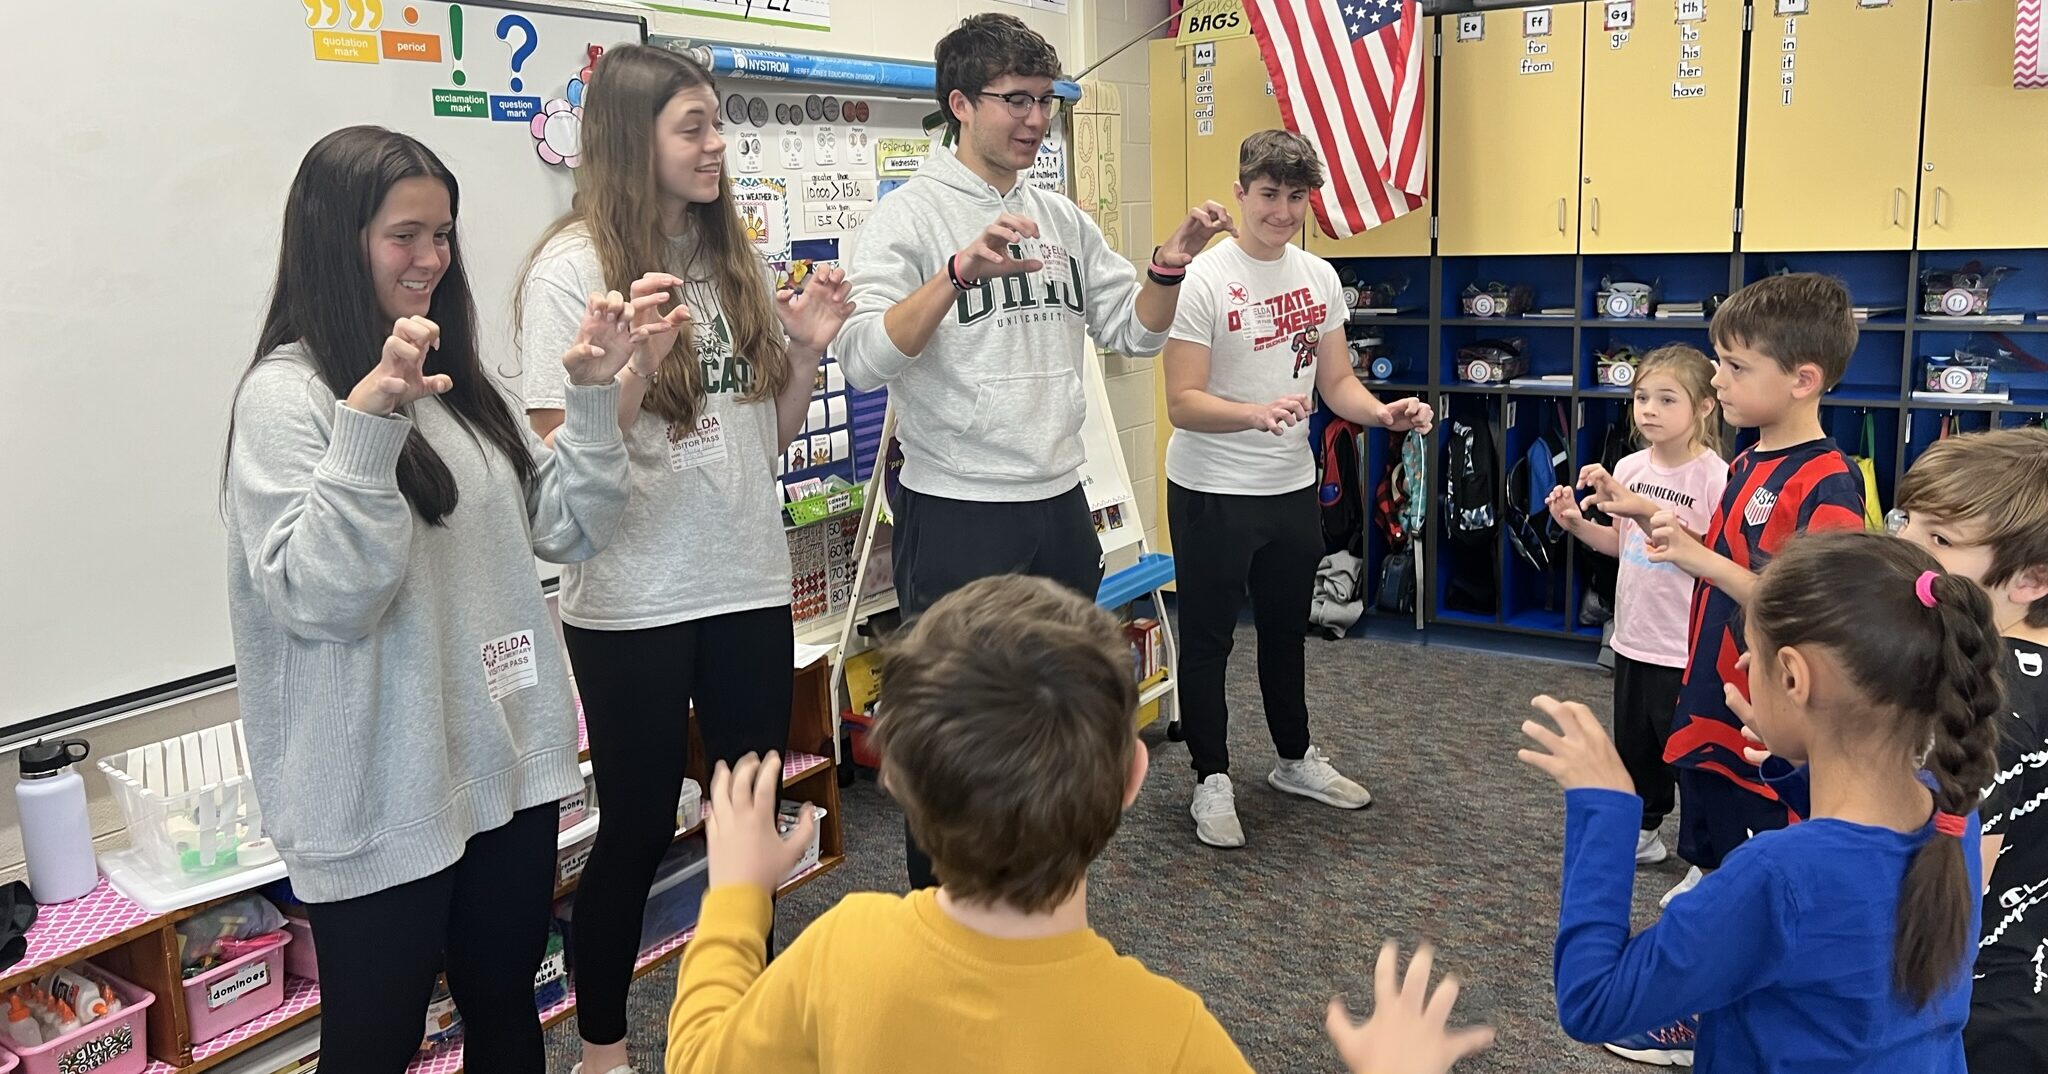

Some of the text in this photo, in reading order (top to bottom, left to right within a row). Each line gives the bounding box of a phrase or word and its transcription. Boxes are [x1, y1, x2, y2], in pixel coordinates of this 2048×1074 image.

[1188, 11, 1240, 34] BAGS
[1531, 16, 1544, 27] Ff
[1611, 10, 1628, 22] Gg
[1463, 22, 1478, 32] Ee
[1785, 18, 1796, 34] if
[1682, 26, 1698, 40] he
[322, 36, 369, 48] quotation
[397, 42, 426, 52] period
[1528, 41, 1546, 53] for
[1612, 33, 1628, 48] go
[1782, 39, 1795, 51] in
[334, 47, 360, 57] mark
[1197, 50, 1211, 59] Aa
[1682, 45, 1700, 59] his
[749, 59, 789, 74] NYSTROM
[1521, 60, 1552, 73] from
[1782, 54, 1793, 68] it
[827, 70, 855, 80] EDUCATION
[855, 73, 876, 81] DIVISION
[1199, 70, 1211, 82] all
[1679, 63, 1701, 77] her
[1782, 73, 1793, 85] is
[1197, 84, 1213, 92] are
[1673, 83, 1704, 98] have
[435, 94, 485, 104] exclamation
[499, 100, 533, 111] question
[1197, 95, 1213, 103] am
[450, 103, 472, 113] mark
[506, 109, 527, 118] mark
[1195, 105, 1214, 118] and
[1199, 120, 1212, 133] an
[878, 140, 930, 154] Yesterday was
[891, 159, 919, 167] Wednesday
[746, 192, 772, 201] WEATHER
[1480, 302, 1487, 312] 5
[1615, 300, 1623, 310] 7
[1475, 367, 1483, 377] 6
[1618, 368, 1626, 379] 8
[1950, 375, 1962, 385] 12
[671, 434, 720, 452] VISITOR PASS
[1755, 488, 1778, 506] USA
[828, 521, 841, 536] 50
[830, 544, 842, 558] 60
[831, 566, 844, 580] 70
[831, 587, 844, 602] 80
[497, 634, 531, 655] ELDA
[498, 646, 532, 661] ELEMENTARY
[487, 656, 529, 676] VISITOR PASS
[560, 799, 584, 812] money
[535, 969, 557, 983] ubes
[213, 969, 265, 1000] dominoes
[76, 1036, 113, 1064] glue
